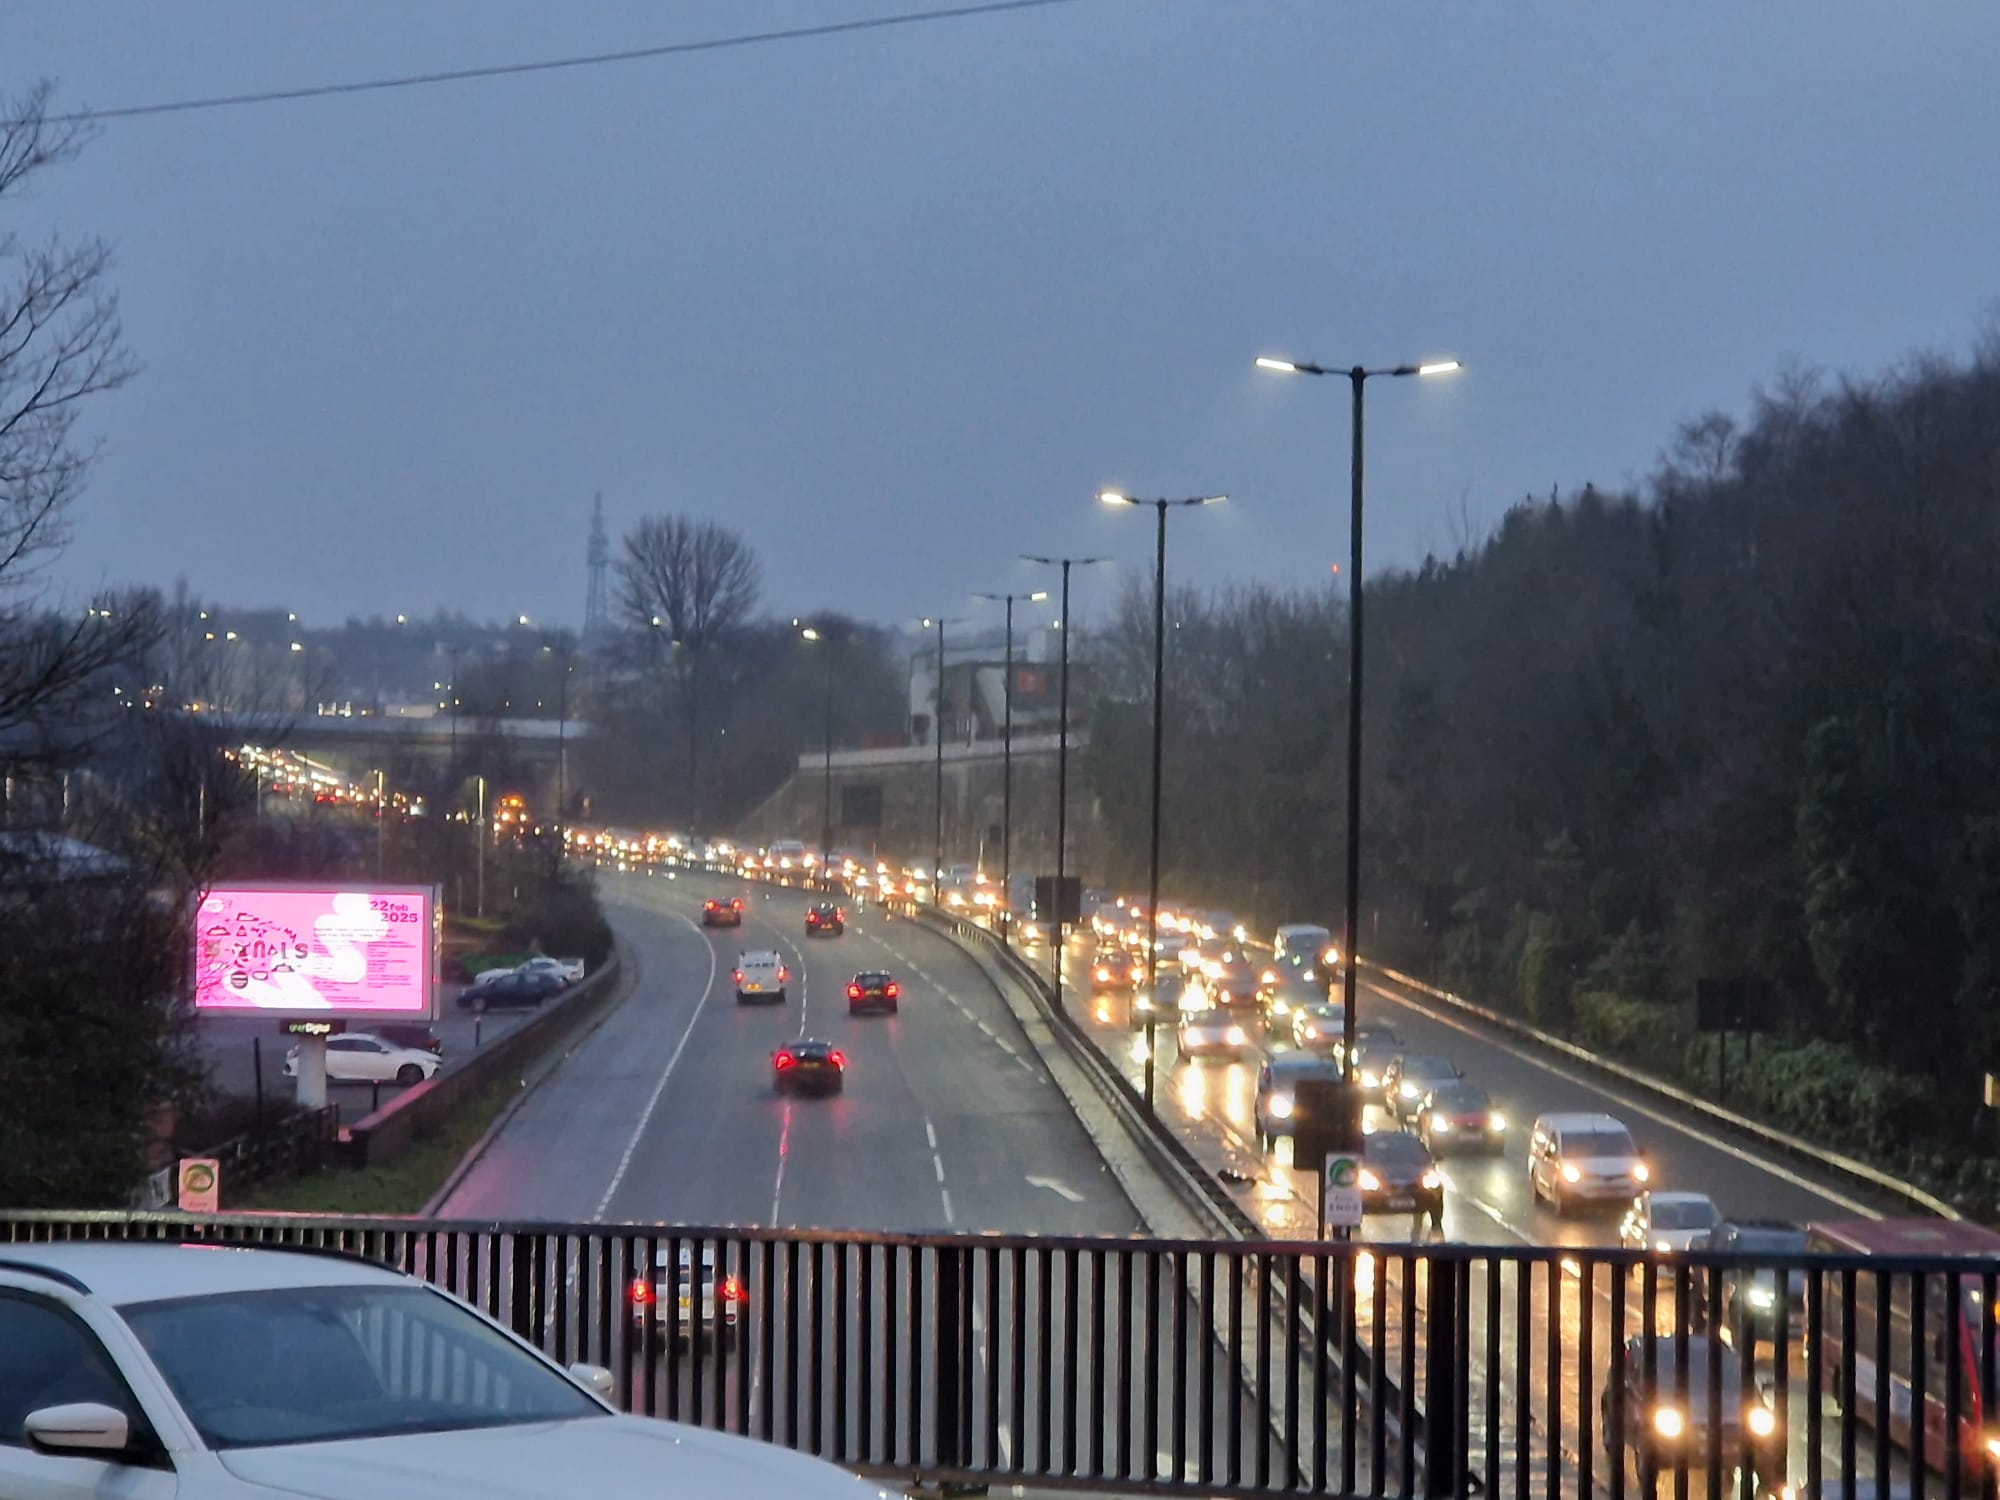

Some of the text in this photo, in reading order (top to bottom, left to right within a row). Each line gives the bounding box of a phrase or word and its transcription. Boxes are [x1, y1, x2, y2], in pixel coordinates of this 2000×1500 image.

[370, 900, 408, 911] 22 feb
[380, 912, 418, 923] 2025
